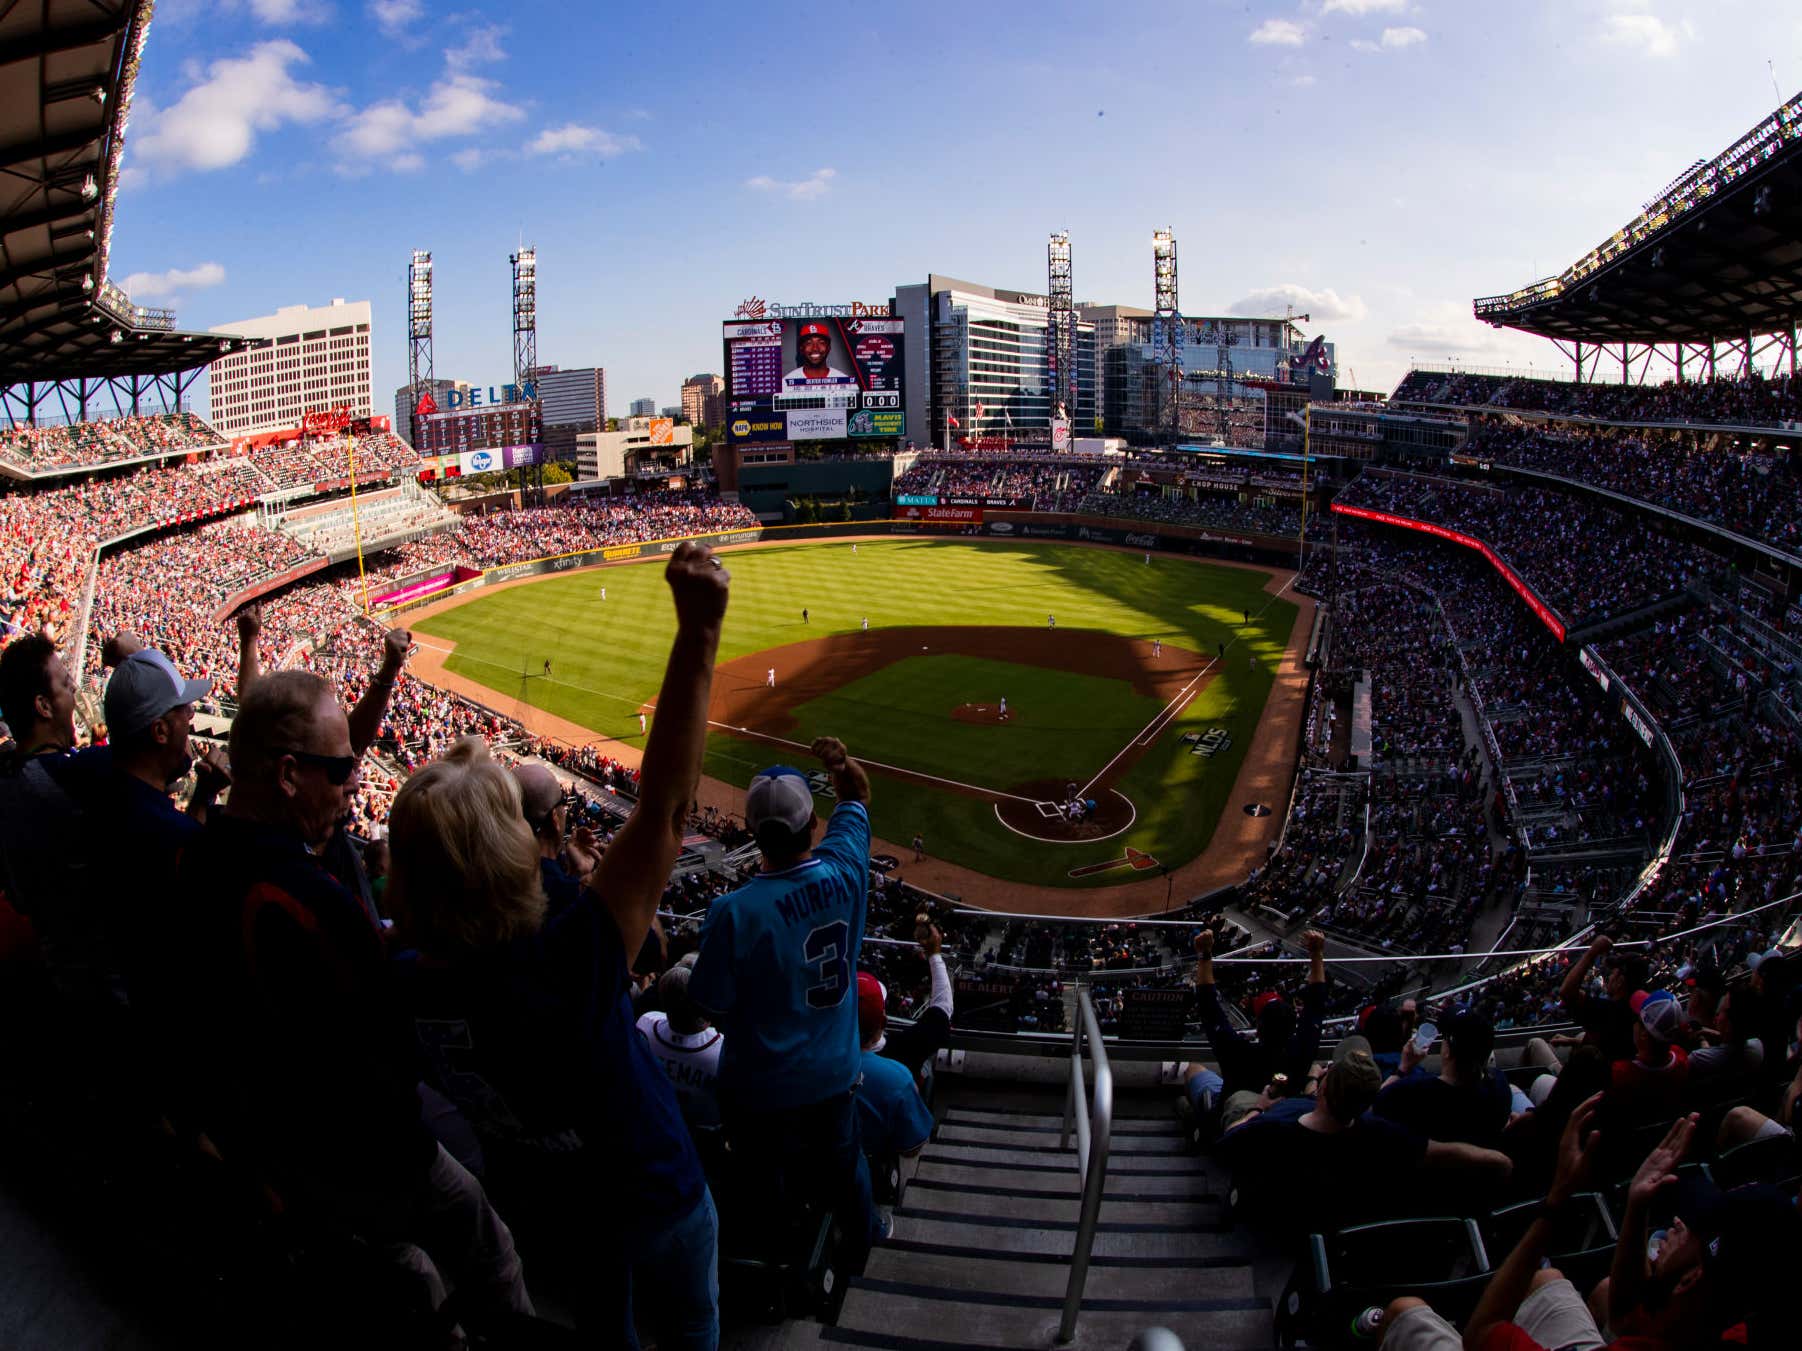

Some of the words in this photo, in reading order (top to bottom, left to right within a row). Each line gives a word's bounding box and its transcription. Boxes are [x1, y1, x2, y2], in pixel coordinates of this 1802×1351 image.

[851, 301, 891, 316] PARK
[737, 325, 767, 336] CARDINALS
[447, 382, 537, 408] DELTA
[867, 396, 873, 406] 0
[879, 396, 885, 406] 0
[890, 396, 896, 405] 0
[735, 424, 748, 432] NAPA
[752, 423, 769, 431] KNOW
[770, 422, 783, 430] HOW
[790, 419, 845, 427] NORTHSIDE
[1213, 483, 1239, 491] HOUSE
[553, 556, 583, 570] xfinity
[1191, 728, 1228, 757] NLDS
[803, 920, 851, 1010] 3
